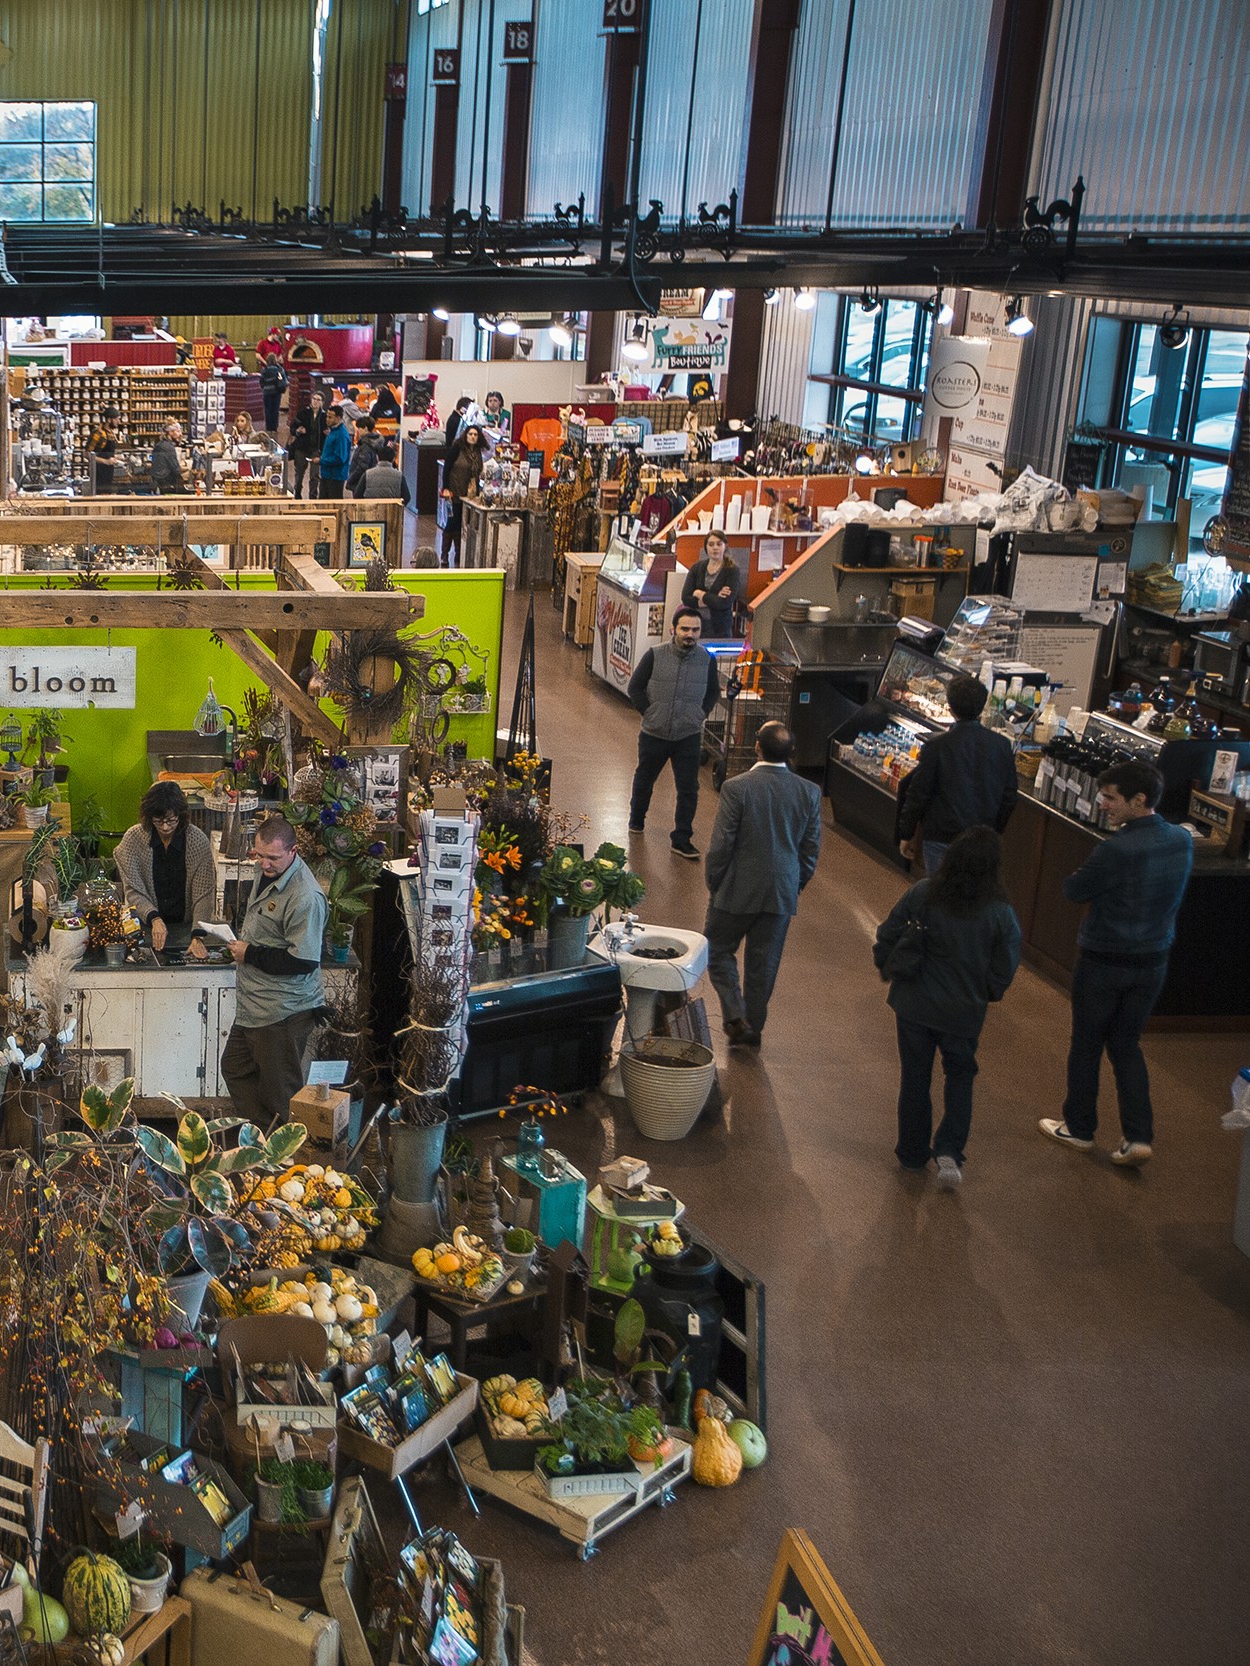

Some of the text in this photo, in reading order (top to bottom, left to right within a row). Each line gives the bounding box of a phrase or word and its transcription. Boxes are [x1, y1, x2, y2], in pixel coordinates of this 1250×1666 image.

[606, 0, 635, 17] 20
[508, 31, 529, 50] 18
[437, 56, 454, 73] 16
[682, 344, 723, 355] FRIENDS
[936, 376, 977, 387] ROASTERS
[618, 624, 627, 645] ICE
[8, 665, 118, 693] bloom
